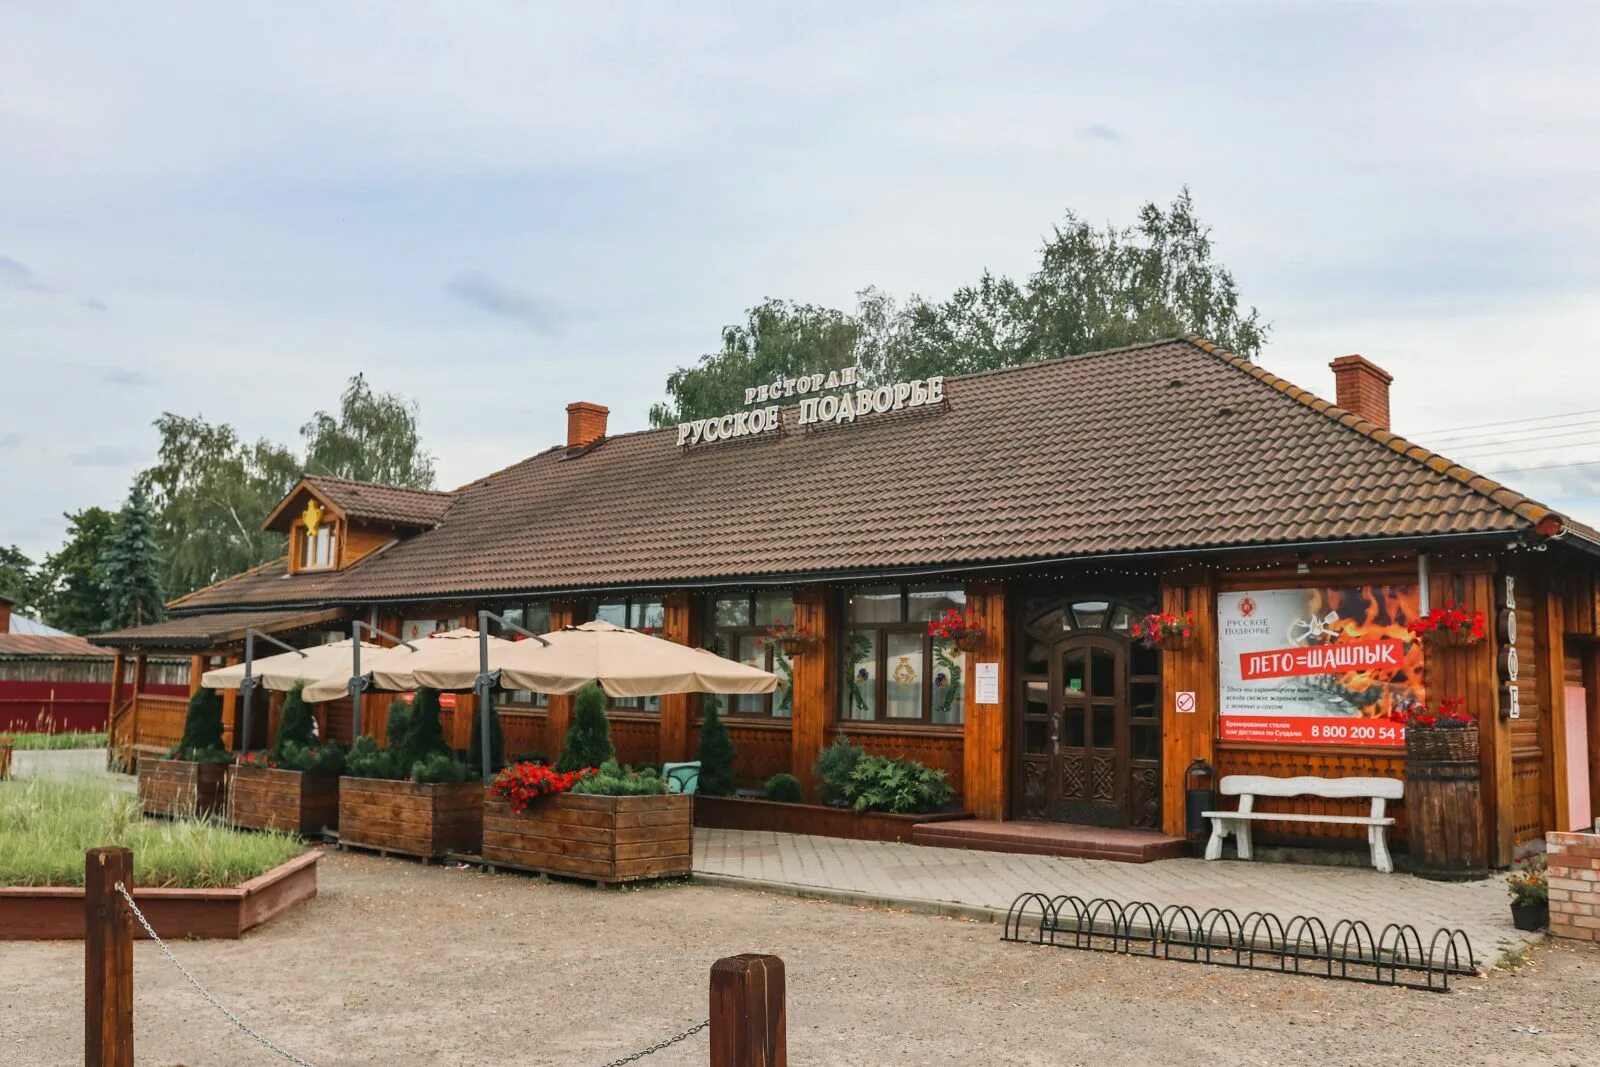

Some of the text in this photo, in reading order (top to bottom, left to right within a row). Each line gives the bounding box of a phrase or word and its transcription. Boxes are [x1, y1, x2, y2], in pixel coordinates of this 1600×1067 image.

[745, 367, 857, 404] РЕСТОРАН
[677, 376, 943, 445] РУССКОЕ ПОДВОРЬЕ
[1226, 618, 1268, 626] РУССКОЕ
[1225, 627, 1271, 635] ПОДВОРЬЕ
[1312, 726, 1319, 737] 8
[1322, 726, 1347, 738] 800
[1350, 727, 1375, 739] 200
[1378, 728, 1396, 739] 54
